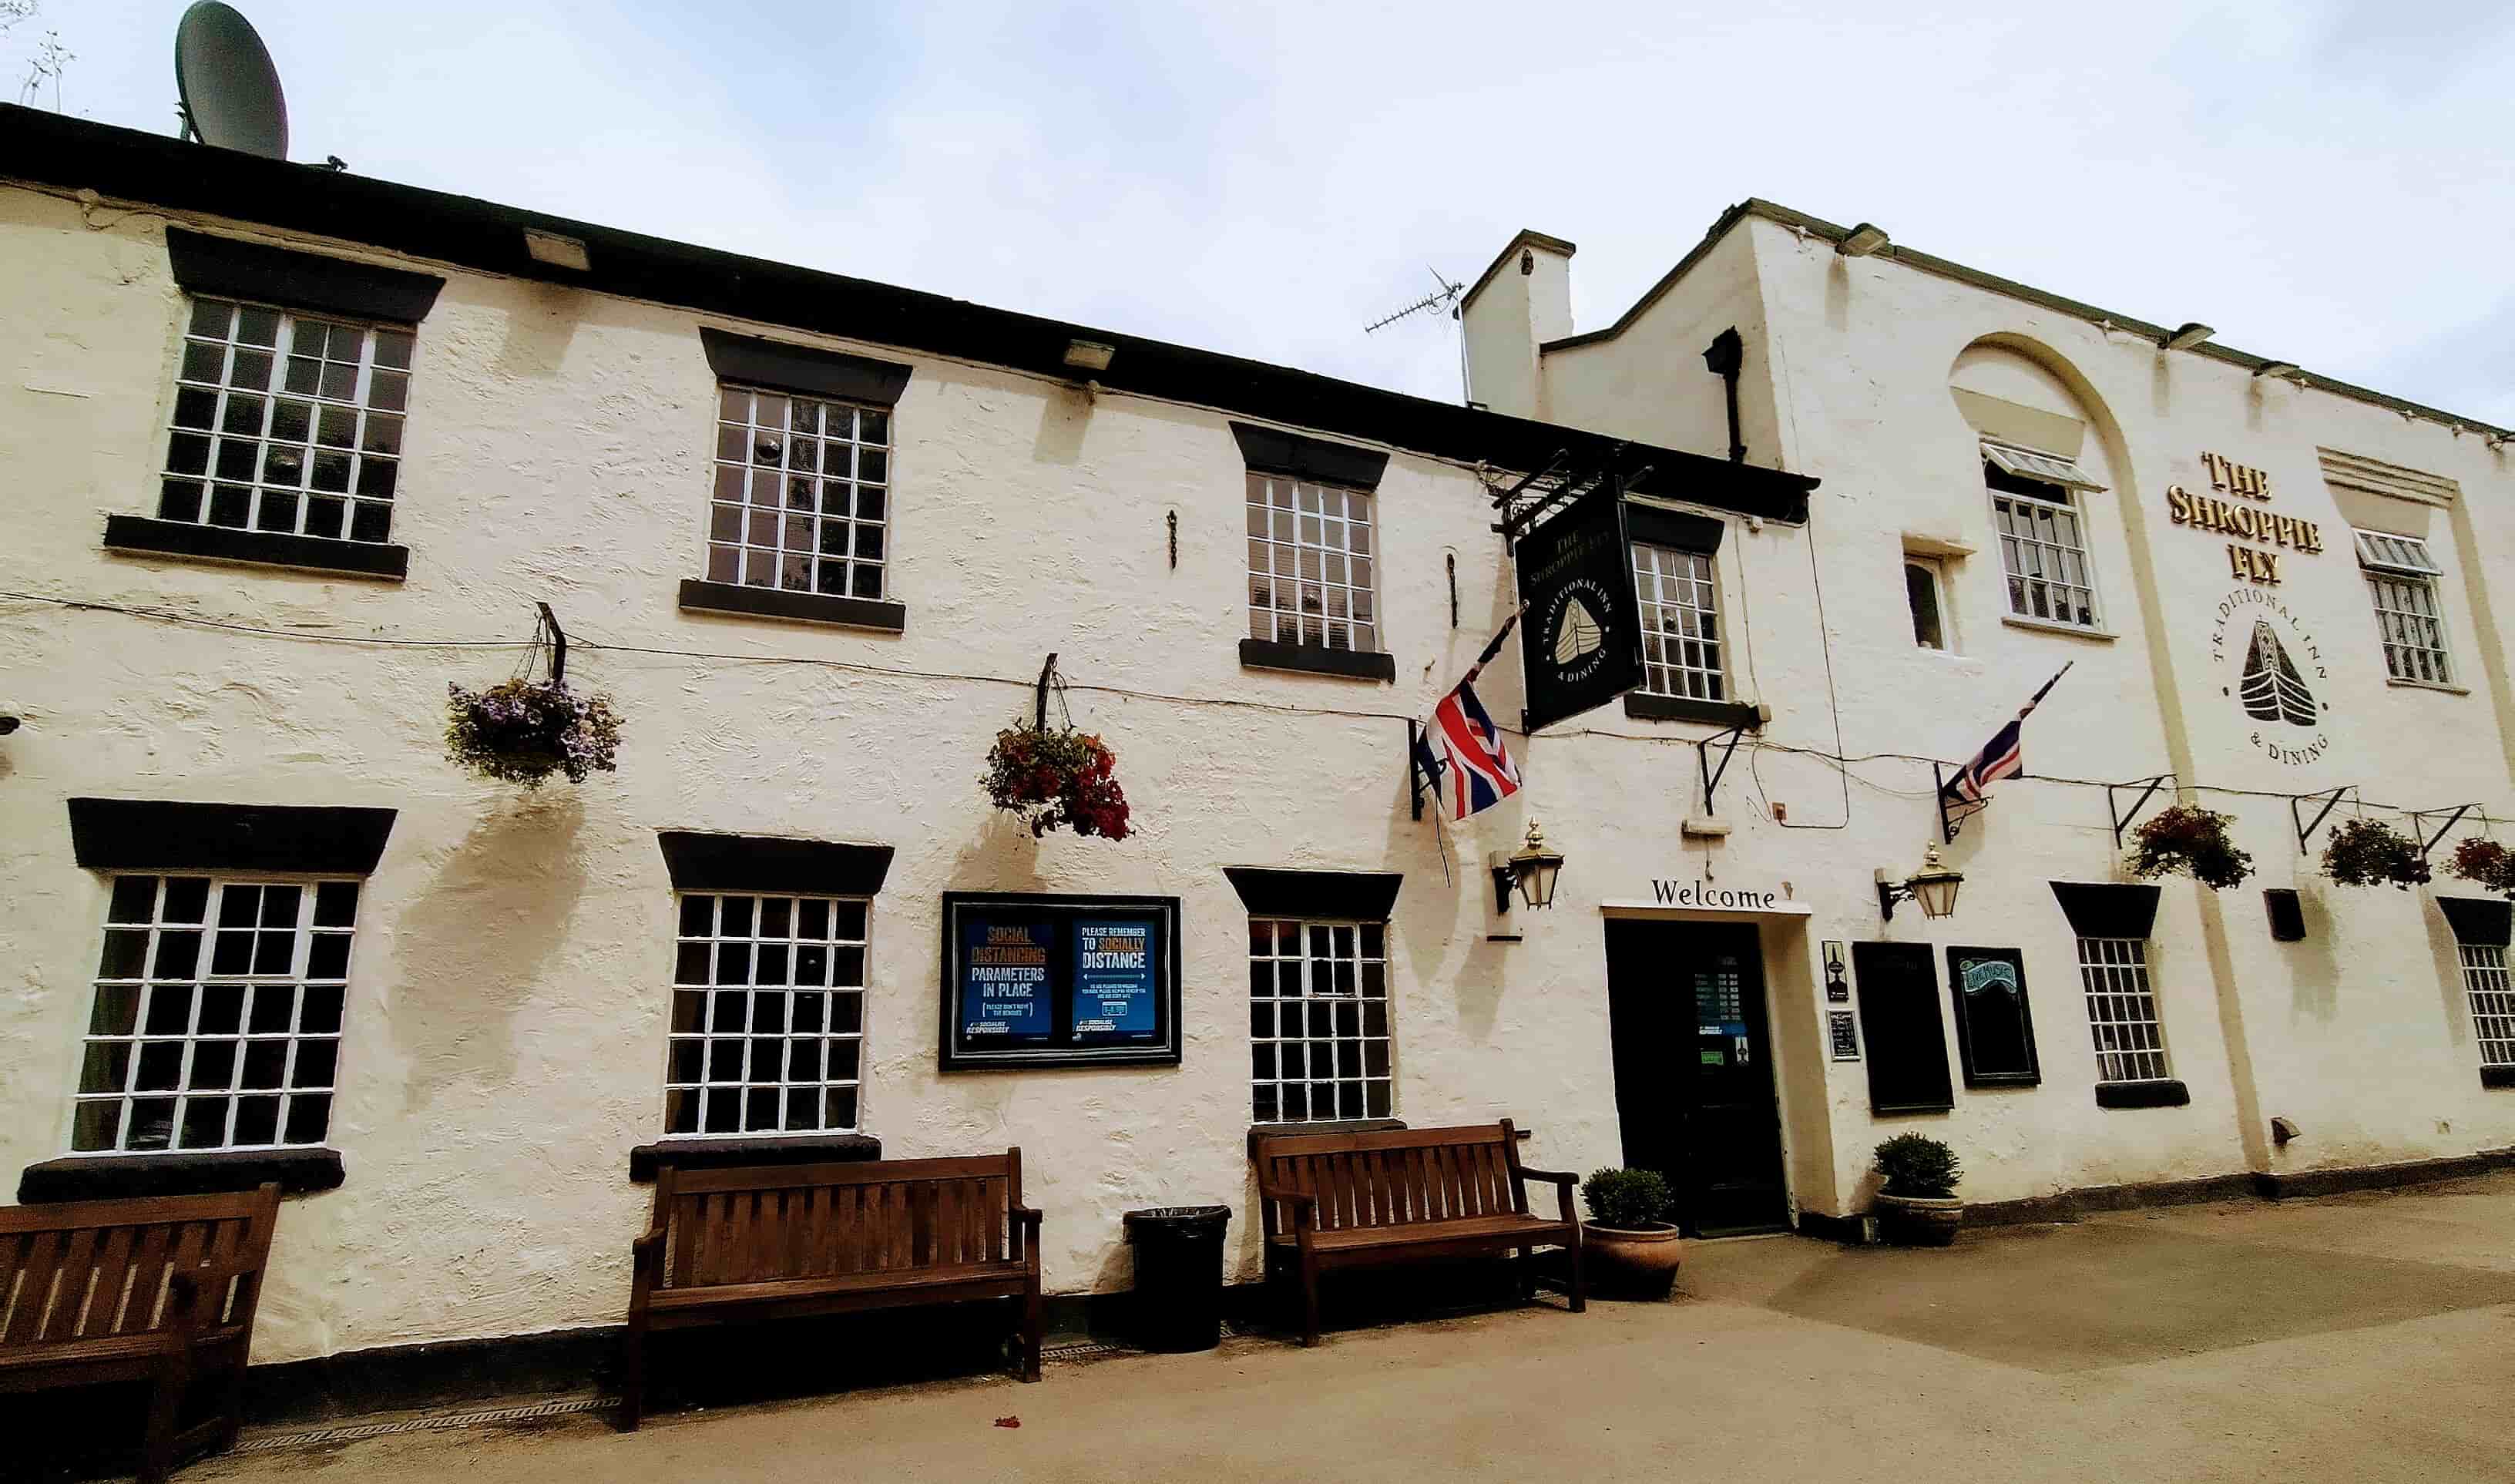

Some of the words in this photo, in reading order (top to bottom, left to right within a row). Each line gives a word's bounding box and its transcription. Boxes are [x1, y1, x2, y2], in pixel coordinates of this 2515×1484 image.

[2201, 451, 2272, 501] THE
[2167, 485, 2324, 555] SHROPPIE
[2227, 544, 2282, 585] FLY
[1543, 578, 1597, 645] TRADITIONAL
[1597, 587, 1613, 614] INN
[2212, 588, 2299, 663] TRADITIONAL
[2302, 635, 2327, 680] INN
[1567, 648, 1607, 683] DINING
[2251, 731, 2261, 747] &
[2268, 733, 2329, 766] DINING
[1651, 879, 1776, 908] Welcome
[987, 926, 1030, 942] SOCIAL
[1082, 928, 1107, 936] PLEASE
[1109, 928, 1146, 937] REMEMBER
[1083, 938, 1096, 950] TO
[1098, 938, 1145, 951] SOCIALLY
[972, 947, 1046, 962] DISTANCING
[1082, 952, 1146, 969] DISTANCE
[972, 967, 1045, 982] PARAMETERS
[982, 983, 996, 997] IN
[999, 983, 1033, 998] PLACE
